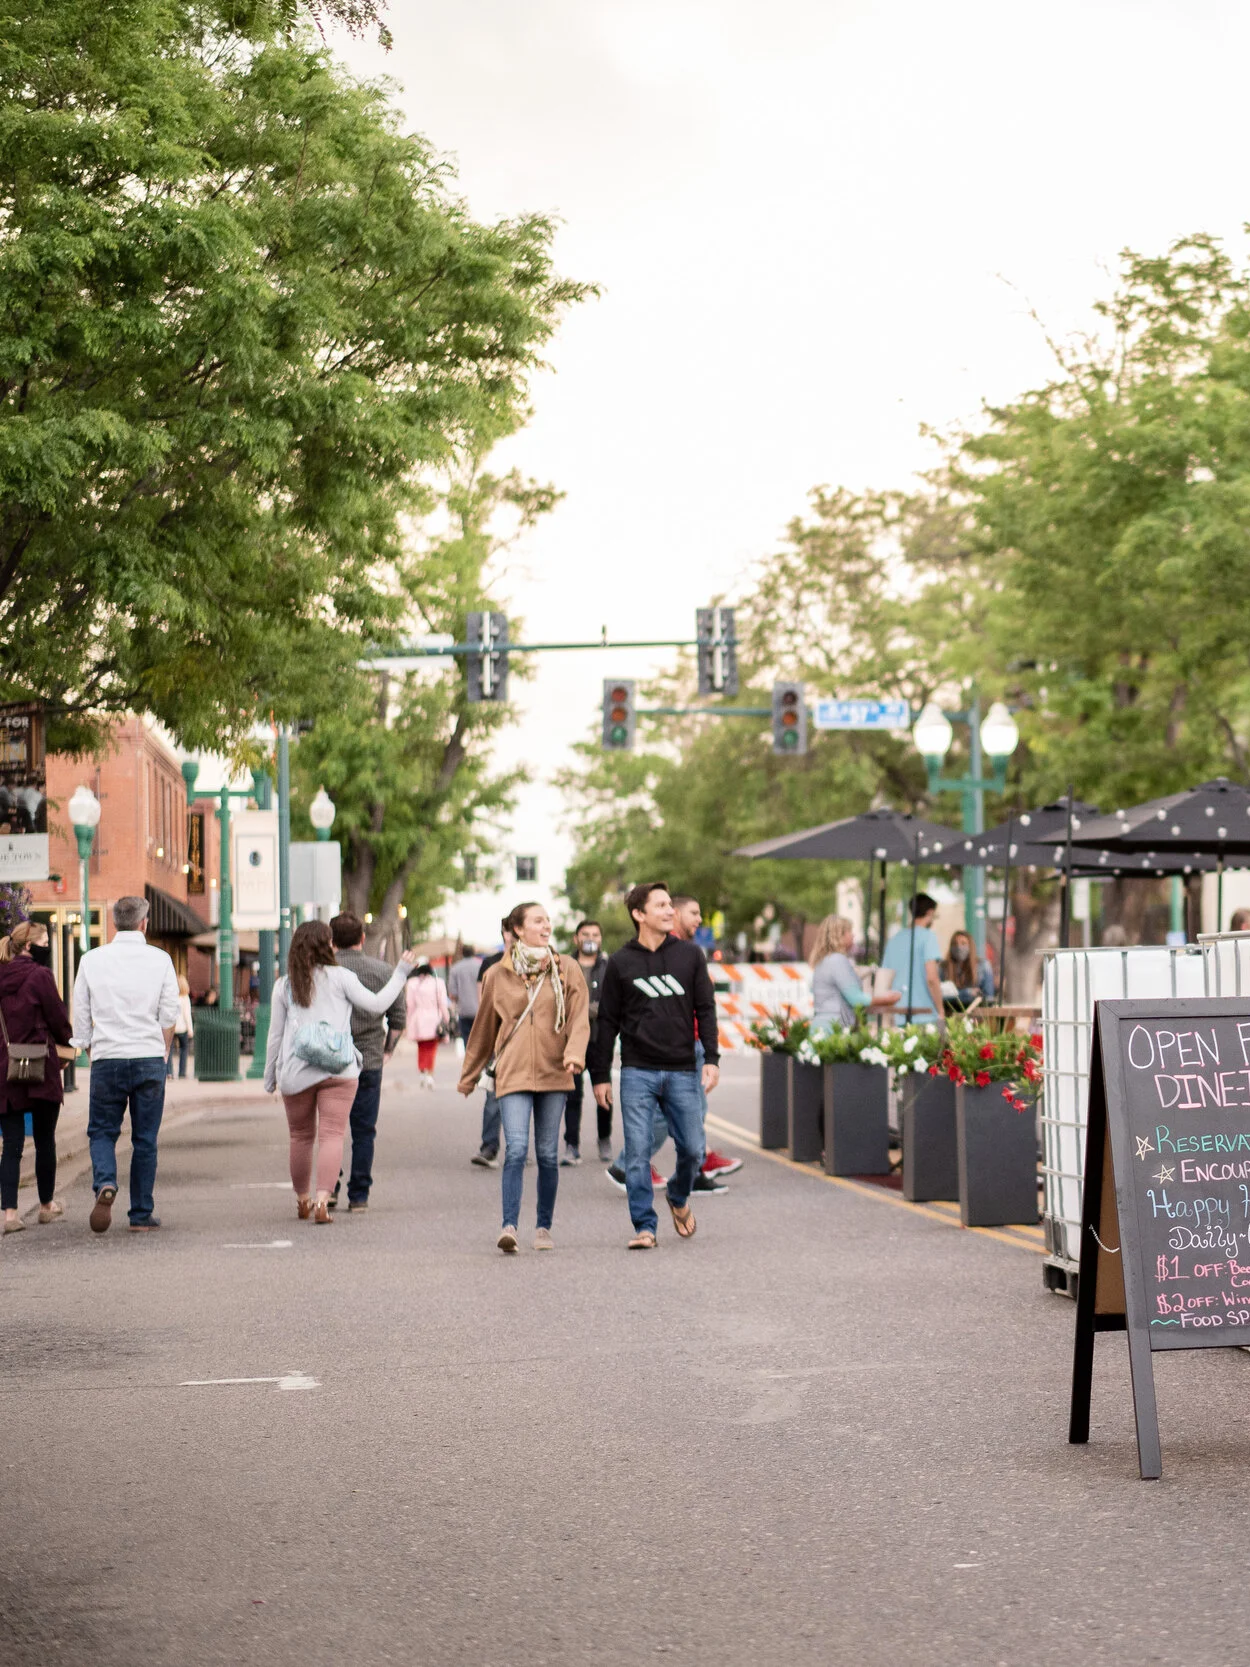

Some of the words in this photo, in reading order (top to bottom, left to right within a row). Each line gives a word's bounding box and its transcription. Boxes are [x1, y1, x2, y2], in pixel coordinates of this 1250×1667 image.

[1128, 1024, 1220, 1069] OPEN
[1146, 1189, 1231, 1230] Happy
[1155, 1254, 1190, 1282] $1
[1193, 1262, 1228, 1278] OFF:
[1180, 1313, 1223, 1328] FOOD
